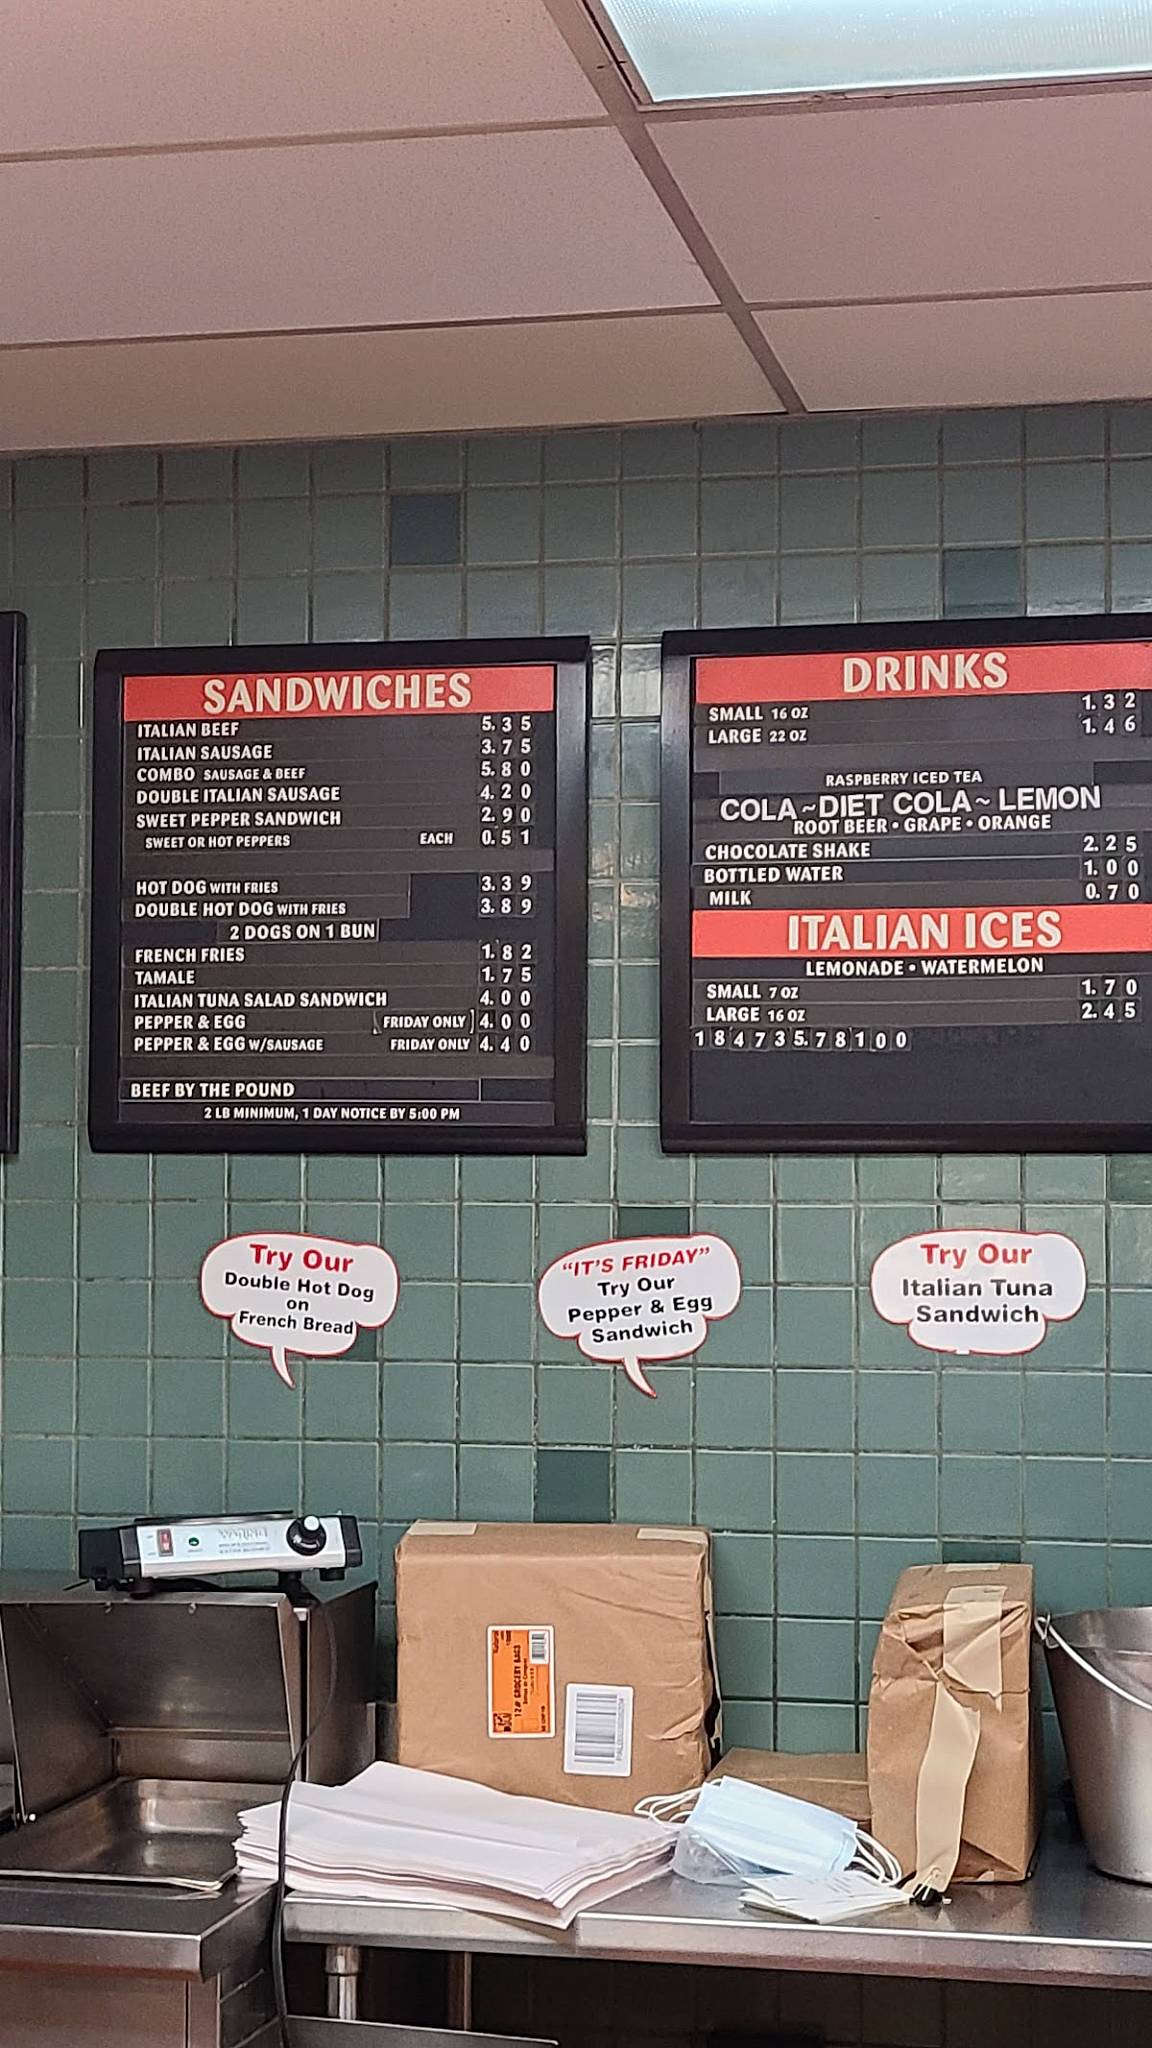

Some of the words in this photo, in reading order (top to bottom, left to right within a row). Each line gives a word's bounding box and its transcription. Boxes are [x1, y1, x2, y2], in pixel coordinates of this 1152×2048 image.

[844, 652, 1007, 692] DRINKS
[204, 673, 470, 713] SANDWICHES
[709, 706, 763, 721] SMALL
[772, 708, 787, 719] 16
[791, 708, 808, 718] OZ
[138, 723, 196, 737] ITALIAN
[202, 722, 238, 736] BEEF
[709, 728, 761, 743] LARGE
[770, 730, 785, 742] 22
[790, 730, 806, 741] OZ
[138, 747, 195, 760] ITALIAN
[201, 745, 272, 759] SAUSAGE
[137, 767, 195, 781] COMBO
[204, 769, 259, 780] SAUSAGE
[263, 769, 272, 779] &
[276, 768, 305, 779] BEEF
[826, 773, 908, 786] RASPBERRY
[913, 772, 949, 784] ICED
[954, 771, 982, 783] TEA
[137, 790, 198, 804] DOUBLE
[204, 788, 262, 802] ITALIAN
[268, 787, 339, 801] SAUSAGE
[721, 798, 797, 821] COLA
[820, 794, 883, 817] DIET
[893, 790, 971, 814] COLA
[999, 786, 1100, 810] LEMON
[137, 814, 186, 828] SWEET
[192, 813, 250, 826] PEPPER
[255, 811, 340, 825] SANDWICH
[794, 820, 839, 834] ROOT
[845, 819, 887, 833] BEER
[904, 817, 961, 832] GRAPE
[978, 814, 1051, 830] ORANGE
[146, 837, 184, 848] SWEET
[188, 837, 205, 847] OR
[209, 836, 233, 847] HOT
[237, 835, 290, 846] PEPPERS
[420, 833, 453, 844] EACH
[706, 844, 807, 860] CHOCOLATE
[813, 843, 870, 858] SHAKE
[705, 867, 780, 883] BOTTLED
[786, 866, 843, 881] WATER
[137, 881, 167, 895] HOT
[172, 880, 206, 894] DOG
[210, 883, 240, 893] WITH
[245, 882, 277, 893] FRIES
[710, 891, 751, 905] MILK
[136, 903, 197, 917] DOUBLE
[203, 903, 234, 916] HOT
[239, 902, 273, 916] DOG
[277, 904, 308, 915] WITH
[312, 903, 345, 914] FRIES
[230, 926, 239, 939] 2
[245, 925, 291, 939] DOGS
[297, 925, 320, 939] ON
[326, 925, 333, 938] 1
[341, 924, 374, 938] BUN
[789, 911, 948, 950] ITALIAN
[966, 911, 1061, 948] ICES
[136, 949, 196, 963] FRENCH
[202, 948, 244, 961] FRIES
[806, 961, 903, 976] LEMONADE
[921, 958, 1043, 974] WATERMELON
[135, 971, 194, 984] TAMALE
[707, 984, 761, 998] SMALL
[769, 987, 777, 998] 7
[781, 987, 798, 999] OZ
[135, 994, 192, 1008] ITALIAN
[198, 993, 239, 1007] TUNA
[245, 993, 295, 1007] SALAD
[300, 992, 386, 1006] SANDWICH
[707, 1007, 759, 1021] LARGE
[768, 1010, 784, 1021] 16
[788, 1010, 805, 1021] OZ
[135, 1016, 193, 1029] PEPPER
[198, 1015, 209, 1029] &
[215, 1015, 245, 1028] EGG
[384, 1016, 429, 1028] FRIDAY
[433, 1016, 466, 1027] ONLY
[135, 1037, 193, 1051] PEPPER
[198, 1037, 209, 1050] &
[214, 1037, 245, 1050] EGG
[249, 1038, 323, 1052] W/SAUSAGE
[391, 1039, 435, 1050] FRIDAY
[438, 1039, 470, 1050] ONLY
[132, 1083, 170, 1097] BEEF
[175, 1083, 195, 1097] BY
[200, 1083, 230, 1097] THE
[236, 1083, 294, 1097] POUND
[205, 1107, 211, 1118] 2
[216, 1107, 230, 1118] LB
[234, 1107, 298, 1120] MINIMUM,
[303, 1108, 308, 1118] 1
[314, 1108, 337, 1118] DAY
[341, 1108, 386, 1118] NOTICE
[390, 1108, 405, 1119] BY
[409, 1108, 437, 1119] 5:00
[441, 1108, 459, 1119] PM
[250, 1244, 292, 1271] Try
[303, 1249, 353, 1272] Our
[921, 1244, 966, 1268] Try
[979, 1244, 1032, 1263] Our
[226, 1272, 289, 1290] Double
[298, 1279, 330, 1295] Hot
[338, 1283, 373, 1302] Dog
[598, 1282, 629, 1297] Try
[638, 1278, 674, 1291] Our
[904, 1278, 981, 1296] Italian
[991, 1280, 1052, 1296] Tuna
[287, 1300, 308, 1311] on
[569, 1305, 641, 1323] Pepper
[651, 1300, 664, 1313] &
[673, 1297, 712, 1313] Egg
[918, 1304, 1038, 1322] Sandwich
[240, 1311, 296, 1328] French
[304, 1317, 353, 1334] Bread
[592, 1320, 692, 1342] Sandwich
